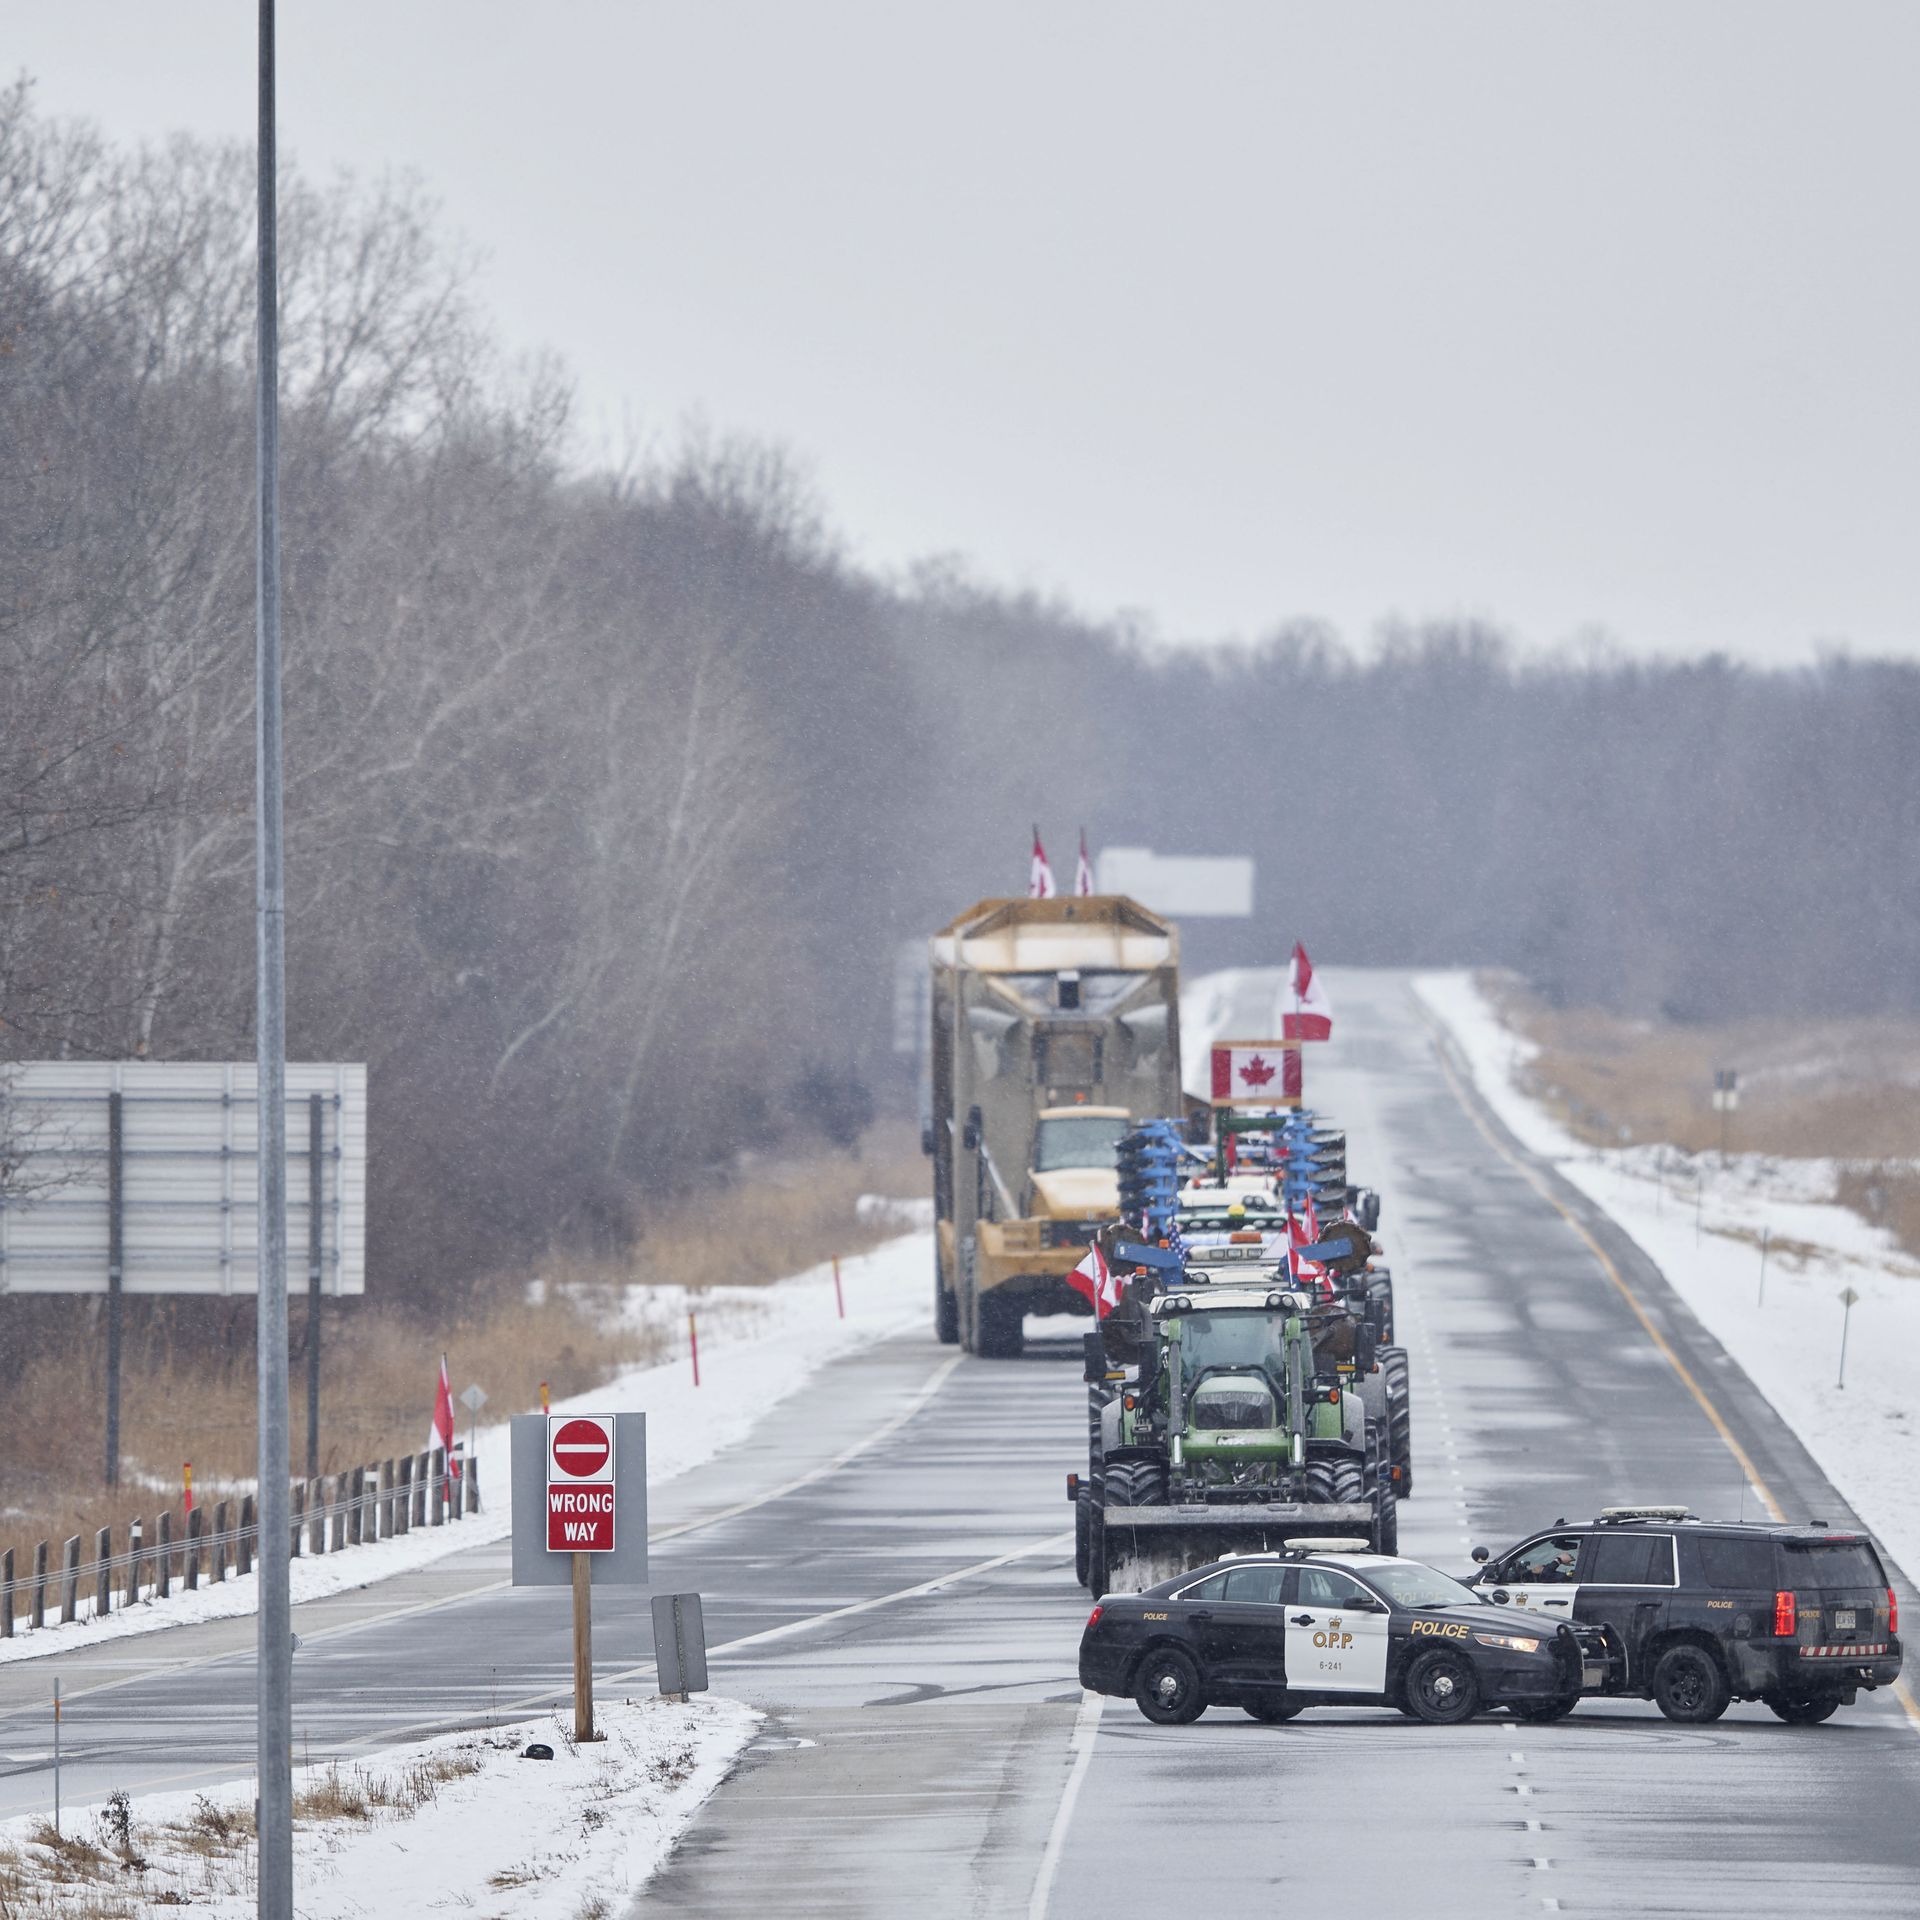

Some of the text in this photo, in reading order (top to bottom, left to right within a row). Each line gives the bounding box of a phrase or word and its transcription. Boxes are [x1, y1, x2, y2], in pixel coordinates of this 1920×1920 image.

[549, 1493, 613, 1513] WRONG
[563, 1522, 598, 1541] WAY
[1707, 1600, 1733, 1609] POLICE
[1143, 1612, 1168, 1621] POLICE
[1411, 1620, 1470, 1639] POLICE
[1313, 1631, 1353, 1649] O.P.P.
[1319, 1661, 1342, 1671] 6-241
